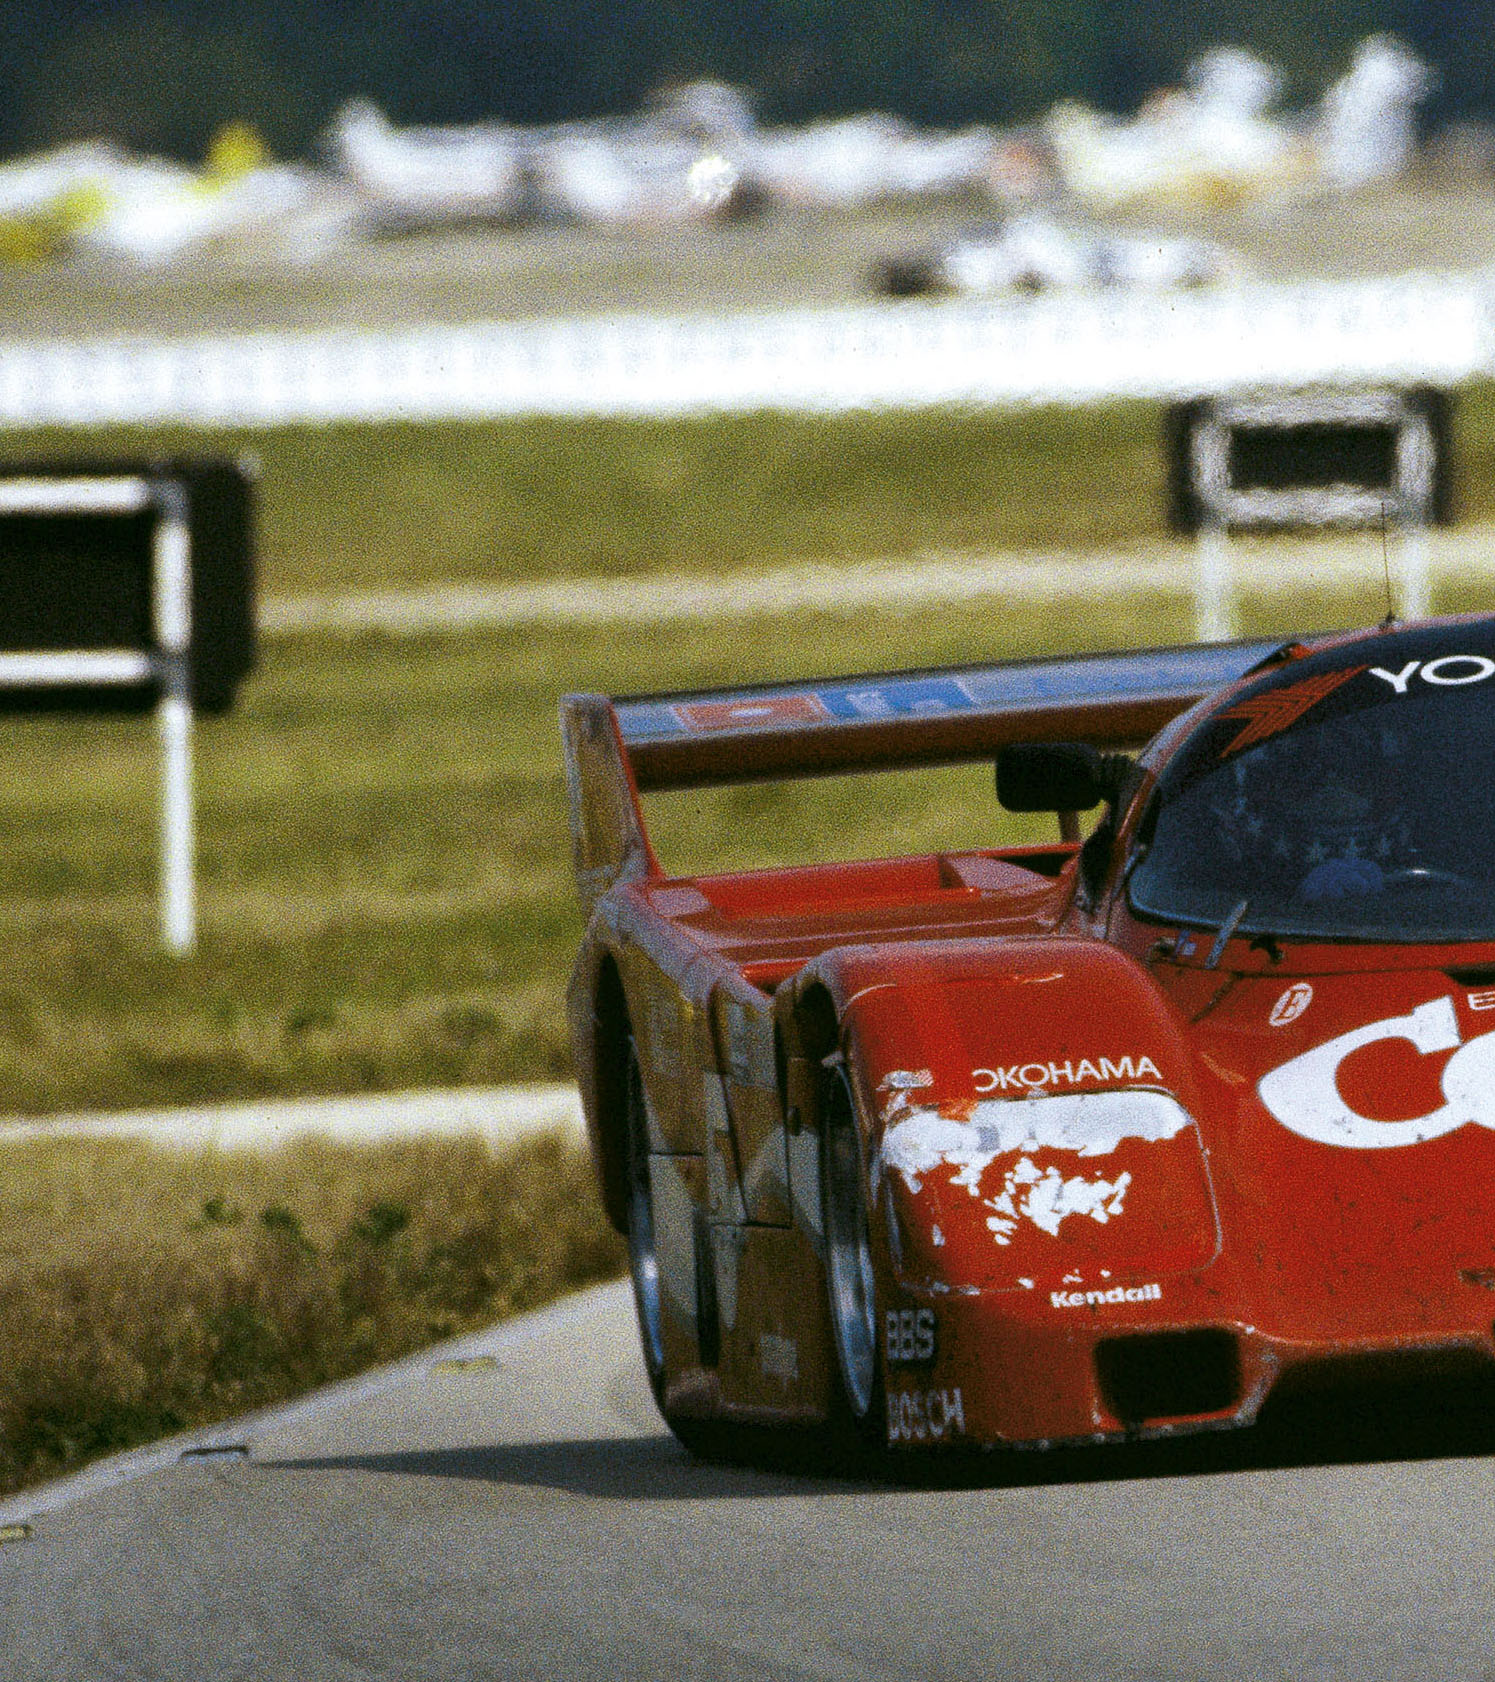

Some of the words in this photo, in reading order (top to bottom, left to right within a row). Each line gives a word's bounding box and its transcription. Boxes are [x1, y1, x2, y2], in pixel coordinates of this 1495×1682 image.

[1050, 1285, 1162, 1308] Kendall
[886, 1309, 935, 1360] BBS
[887, 1387, 967, 1440] BOSCH
